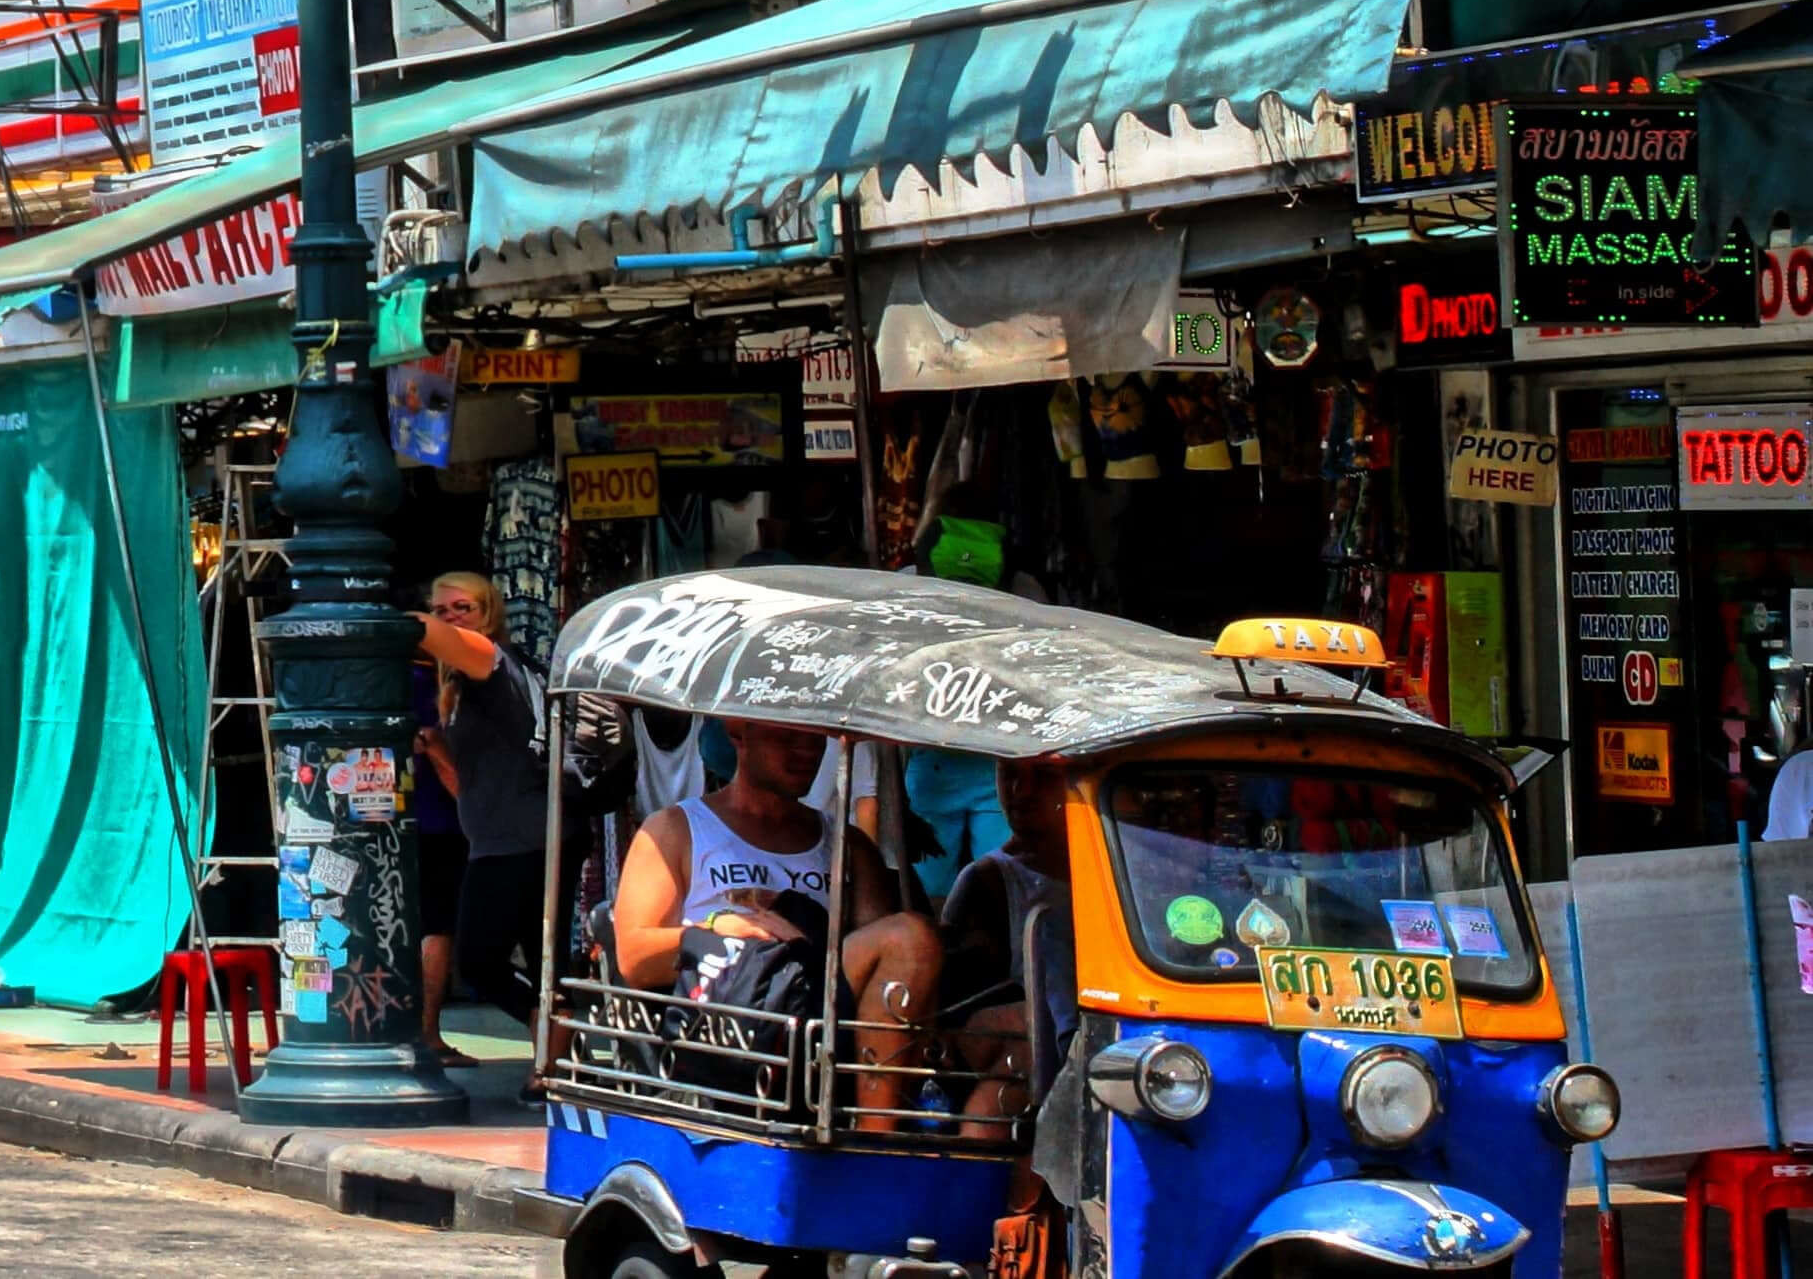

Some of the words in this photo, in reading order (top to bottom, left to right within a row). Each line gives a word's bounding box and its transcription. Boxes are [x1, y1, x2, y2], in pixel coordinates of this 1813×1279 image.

[257, 44, 296, 98] PHOTO
[1534, 173, 1699, 223] SIAM
[182, 192, 305, 286] PARCE
[1638, 285, 1675, 300] side
[476, 352, 565, 380] PRINT
[1455, 434, 1556, 466] PHOTO
[1683, 428, 1808, 486] TATTOO
[573, 467, 656, 504] PHOTO
[1468, 467, 1535, 493] HERE
[1573, 486, 1621, 514] DIGITAL
[1573, 528, 1632, 556] PASSPORT
[1635, 527, 1675, 555] PHOTO
[1572, 571, 1623, 599] BATTERY
[1262, 624, 1367, 653] TAXI
[1580, 613, 1633, 641] MEMORY
[1636, 614, 1671, 642] CARD
[1581, 654, 1616, 682] BURN
[1623, 650, 1659, 706] CD
[1627, 753, 1661, 772] Kodak
[710, 863, 770, 889] NEW
[1348, 956, 1448, 1002] 1036
